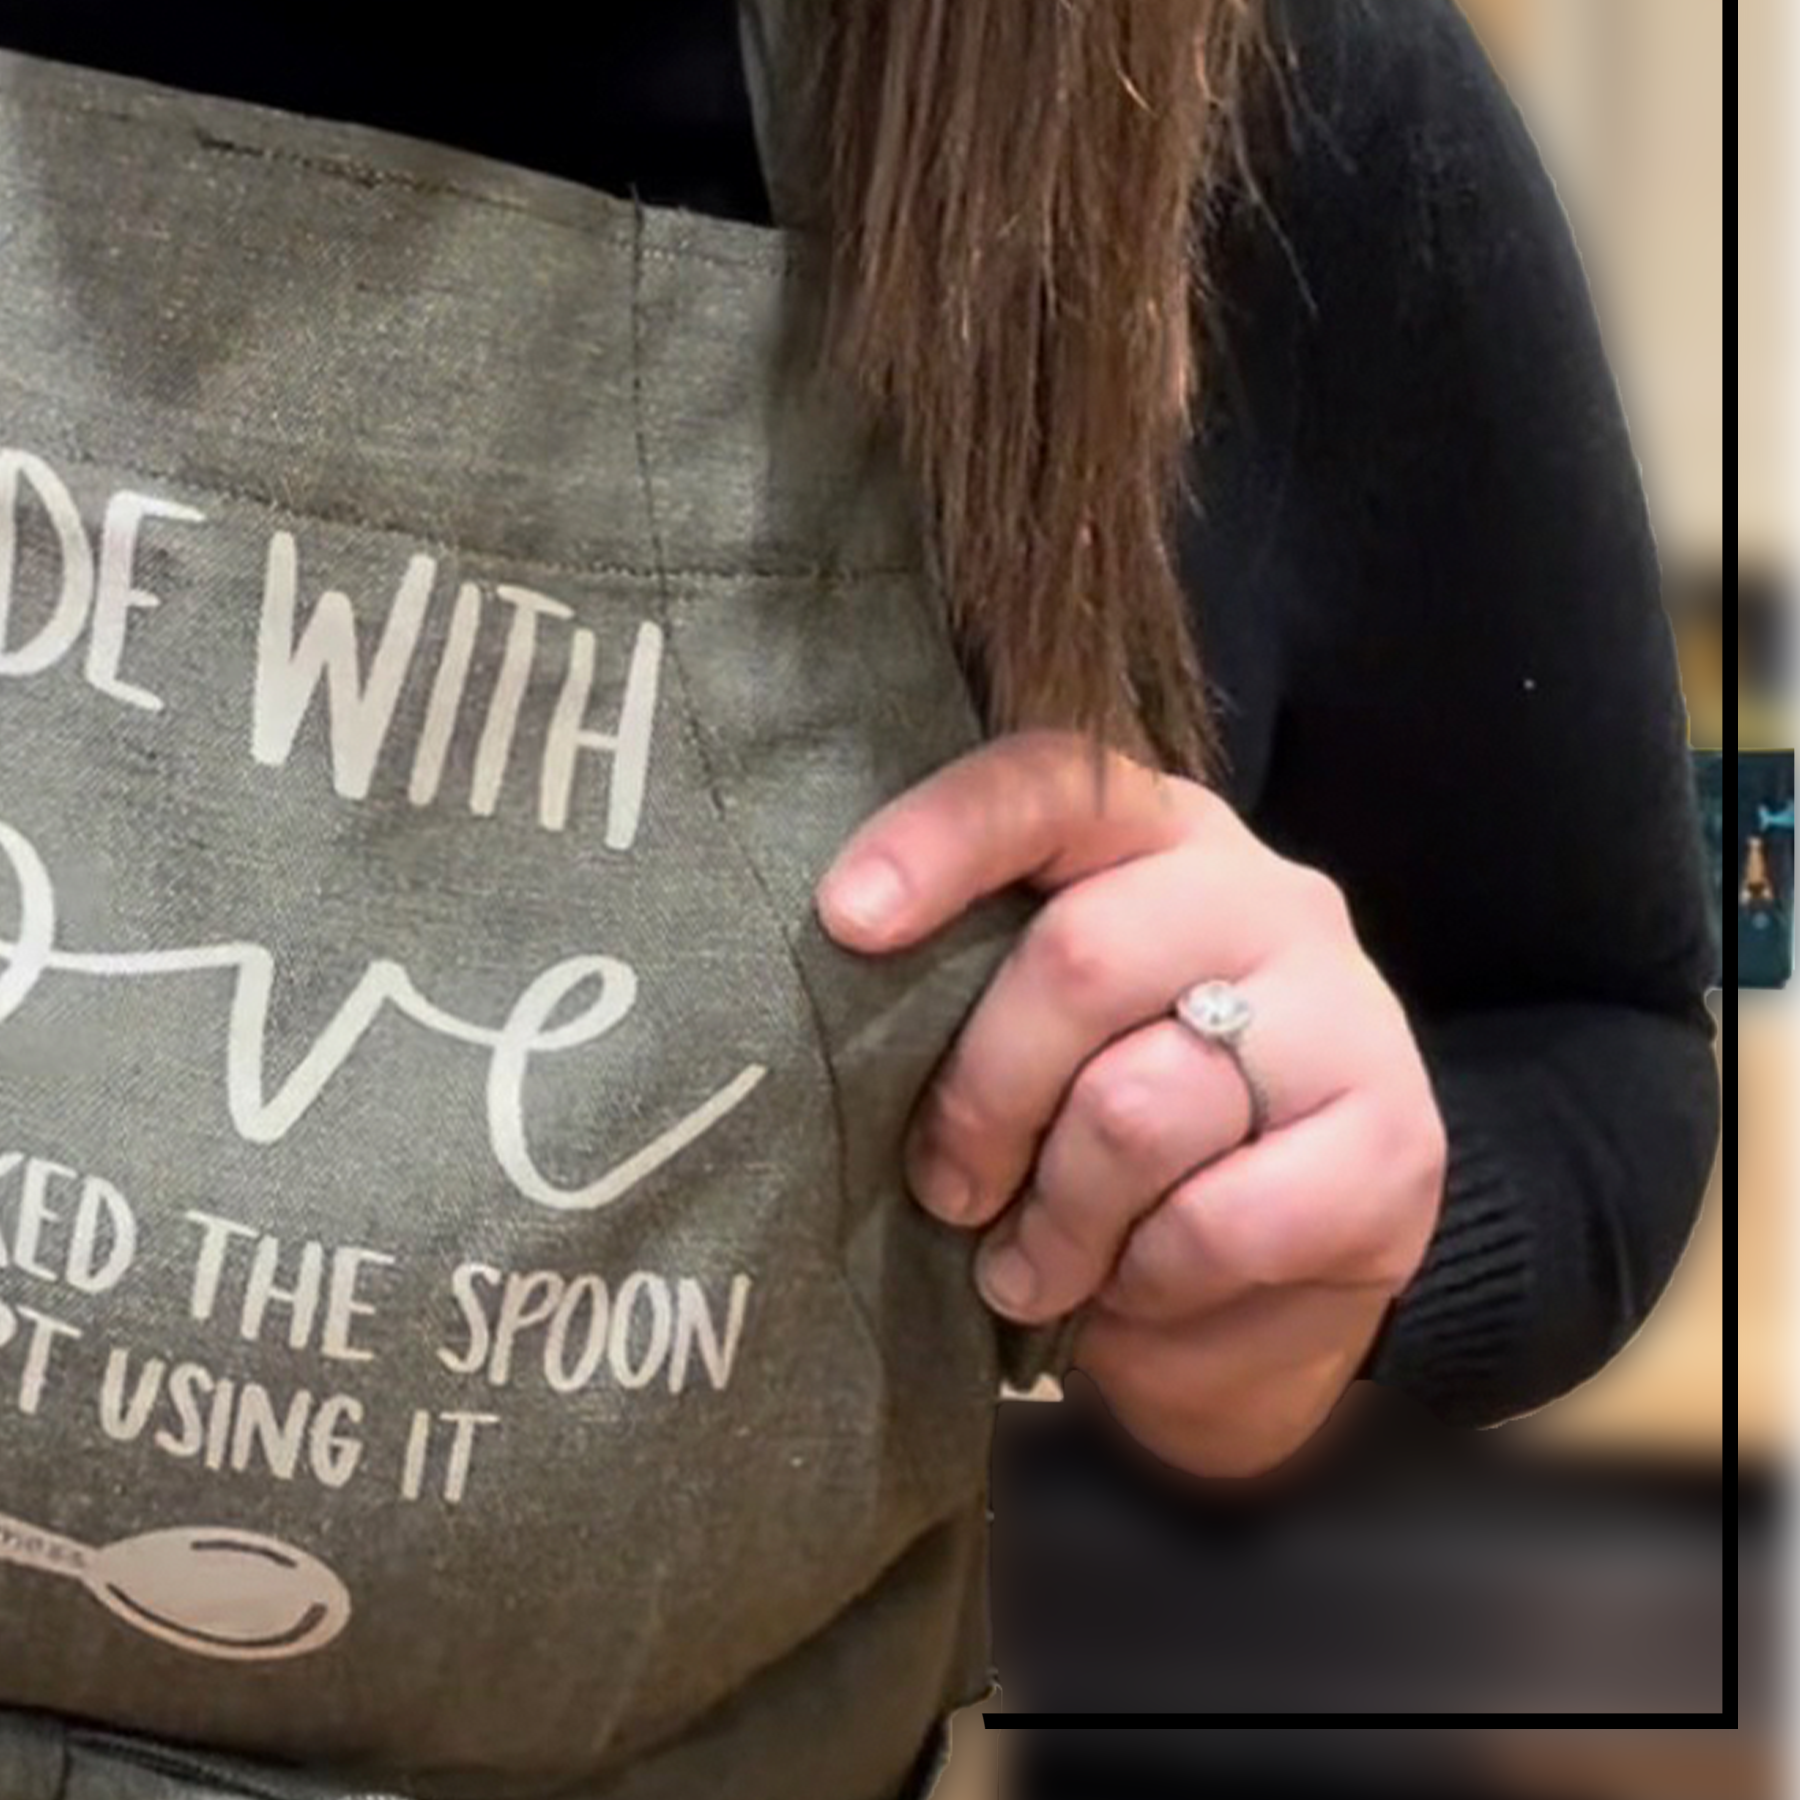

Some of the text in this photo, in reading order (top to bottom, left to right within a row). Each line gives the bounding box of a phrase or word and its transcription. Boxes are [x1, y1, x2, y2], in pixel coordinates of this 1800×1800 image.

[250, 531, 661, 850] WITH
[186, 1210, 394, 1361] THE
[437, 1263, 752, 1393] SPOON
[100, 1346, 364, 1488] USING
[400, 1410, 501, 1503] IT
